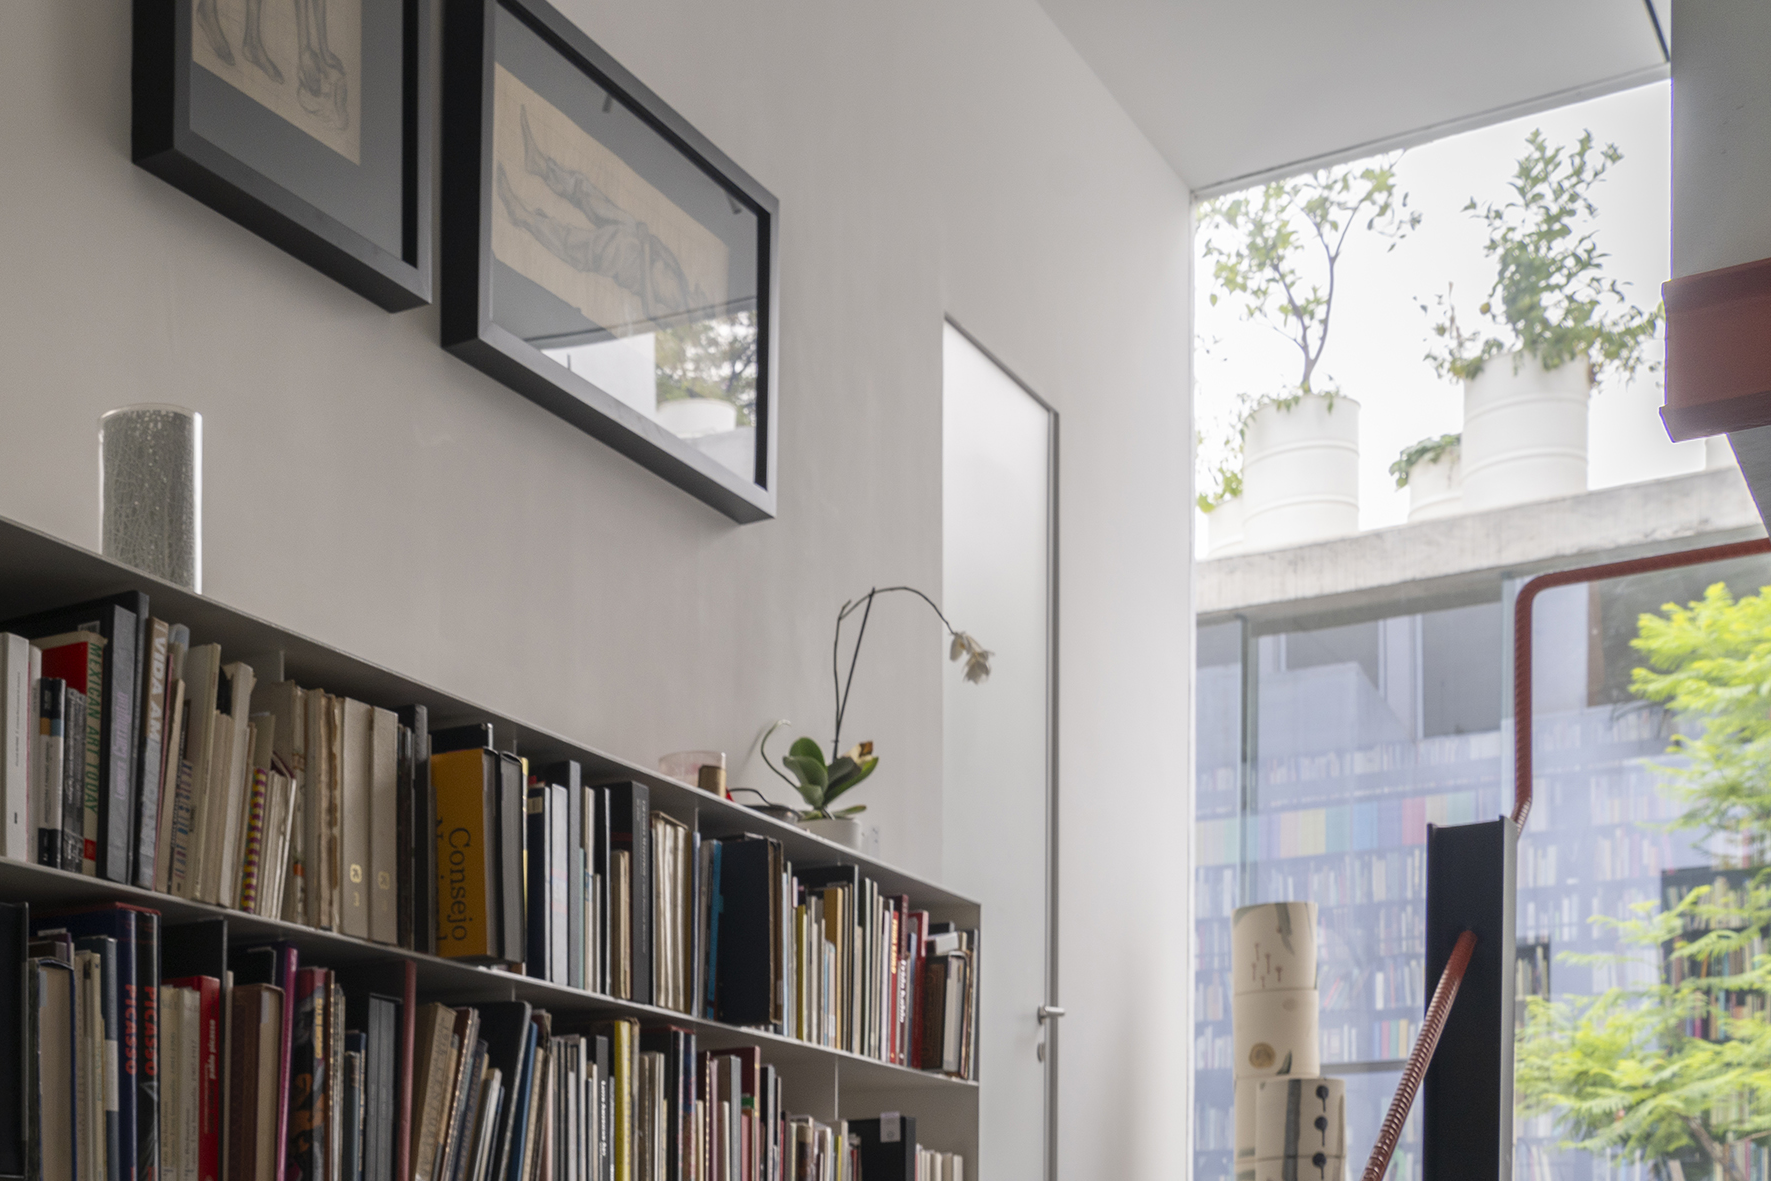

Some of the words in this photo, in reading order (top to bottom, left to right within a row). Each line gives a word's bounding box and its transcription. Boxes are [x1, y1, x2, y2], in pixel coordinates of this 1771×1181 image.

[88, 642, 102, 719] MEXICAN
[150, 636, 166, 698] VIDA
[86, 724, 99, 757] ART
[85, 761, 99, 814] TODAY
[447, 826, 473, 942] Consejo
[124, 983, 137, 1075] PICASSO
[143, 985, 158, 1076] PICASSO
